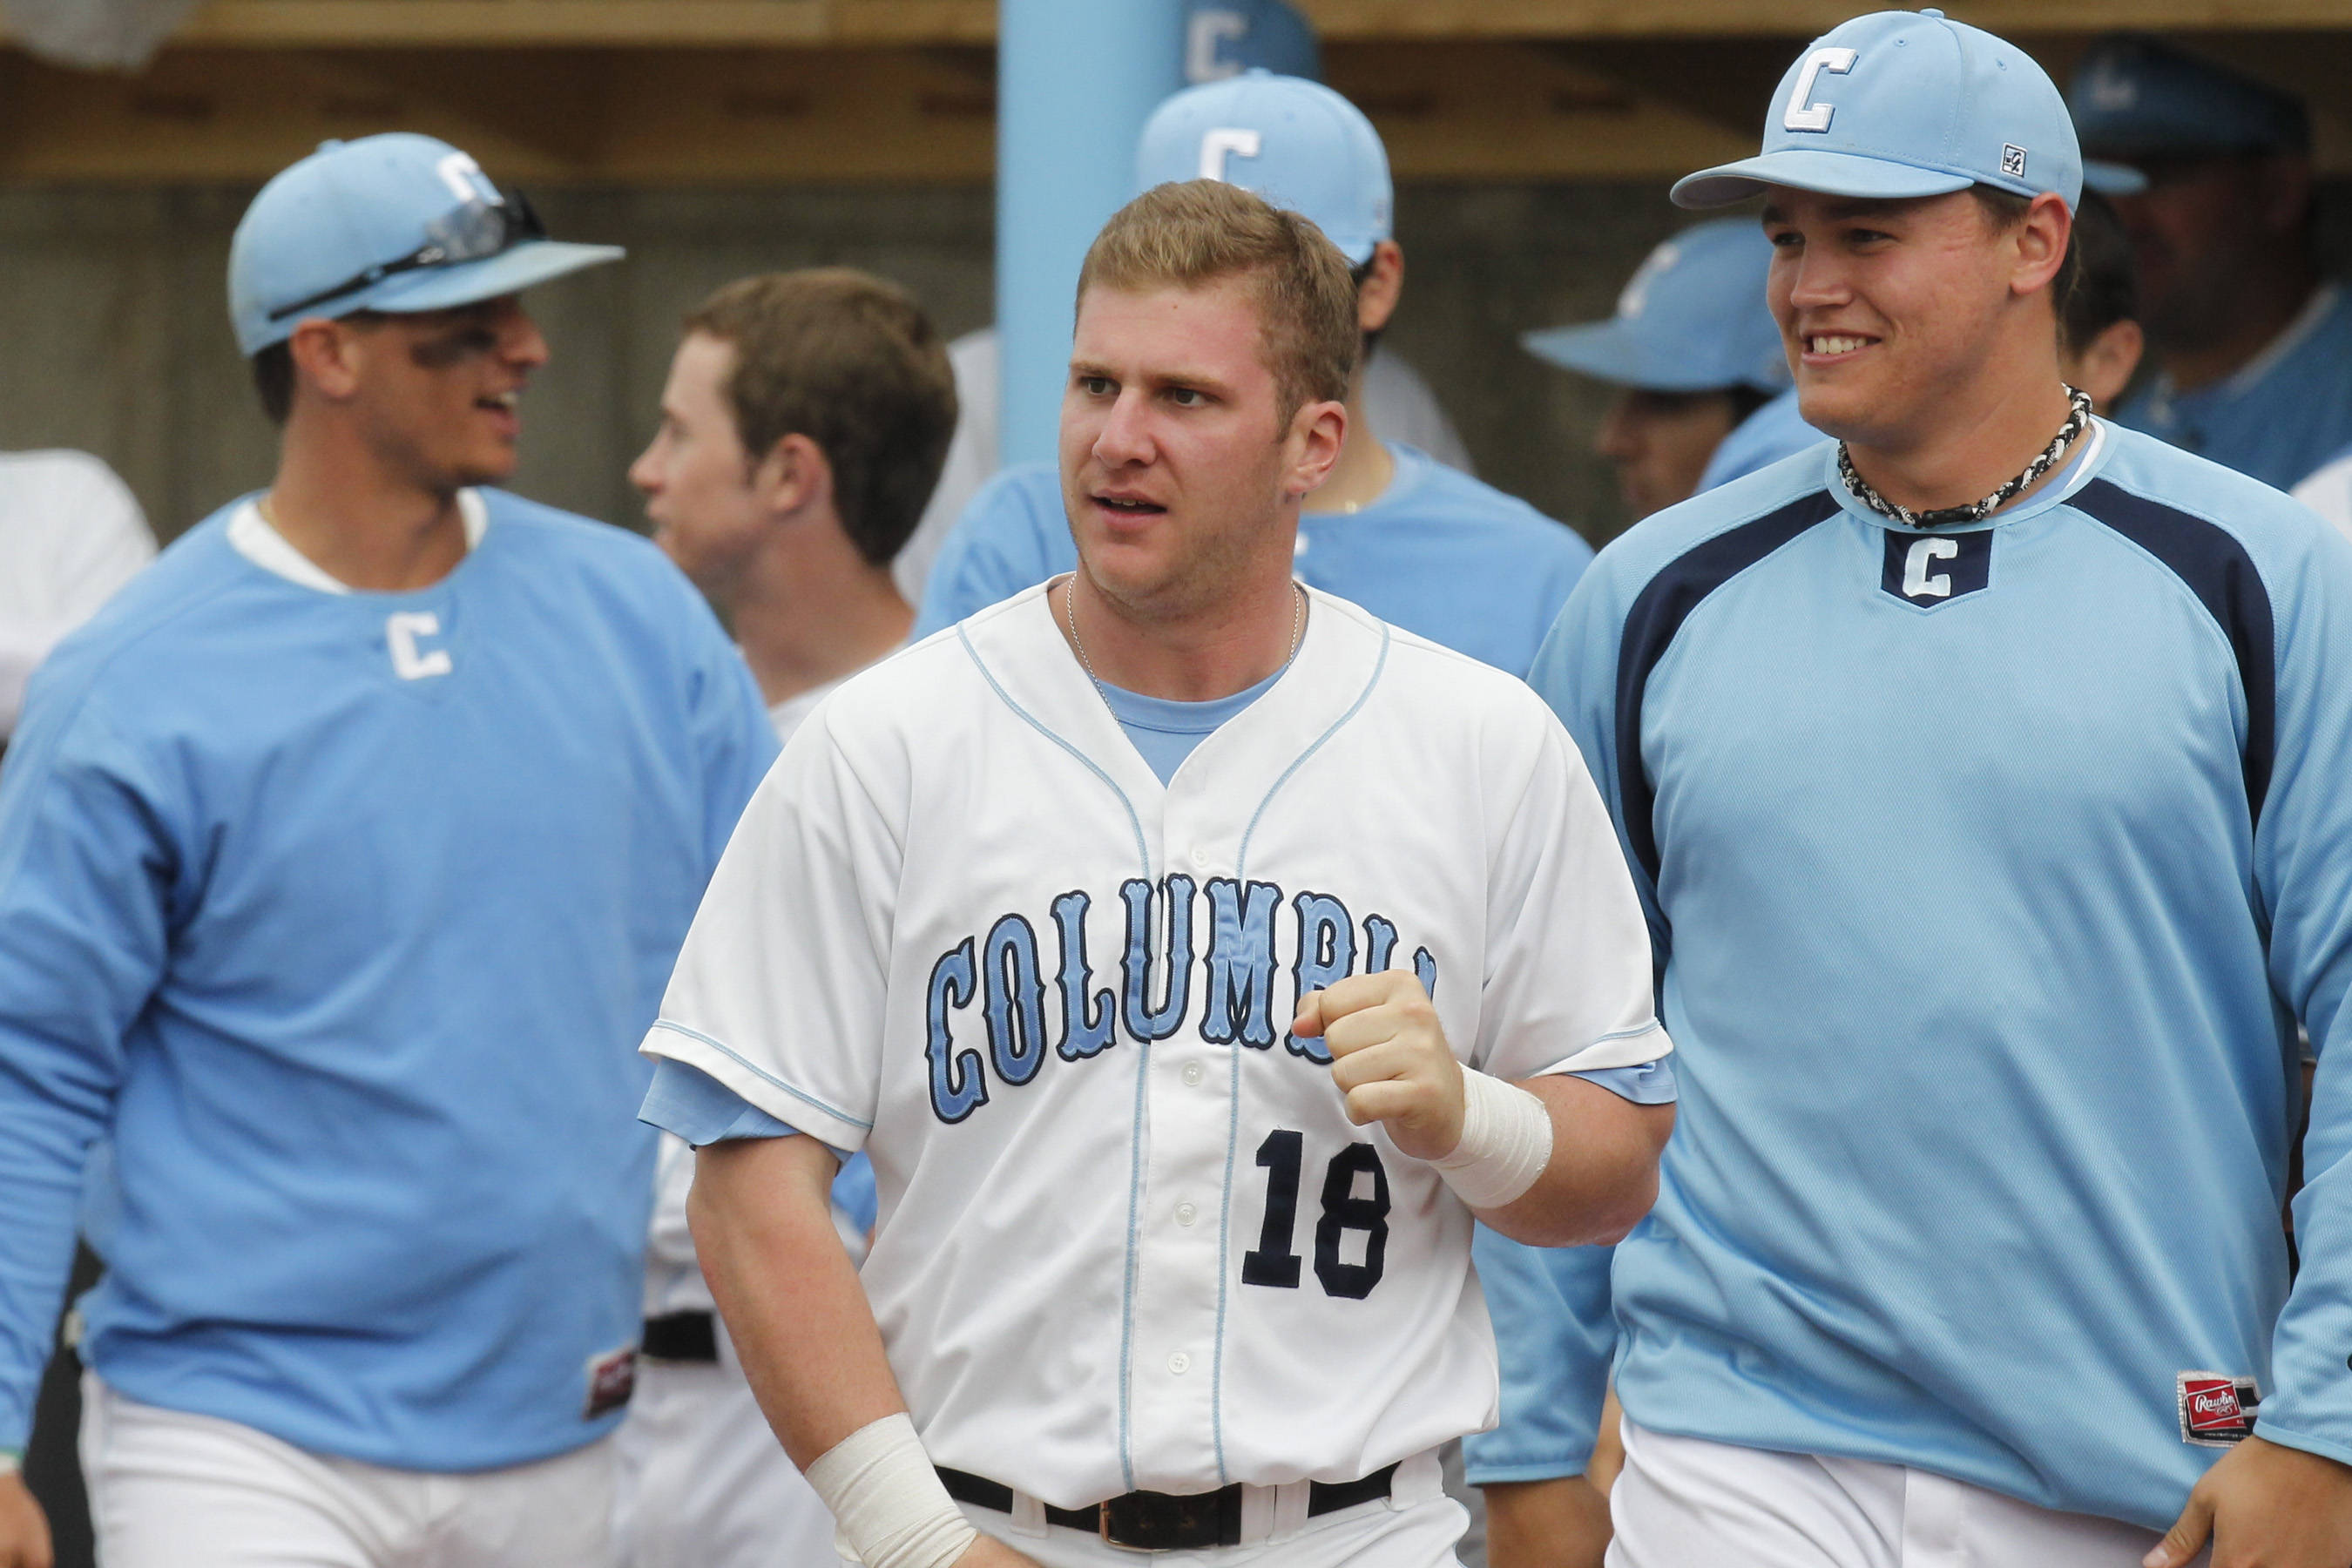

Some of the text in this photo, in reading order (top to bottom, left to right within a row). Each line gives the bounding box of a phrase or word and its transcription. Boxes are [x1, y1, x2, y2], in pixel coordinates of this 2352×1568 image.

[1186, 10, 1247, 84] C
[1784, 47, 1859, 134] C
[1903, 537, 1958, 598] C
[385, 611, 452, 679] C
[1241, 1129, 1391, 1300] 18
